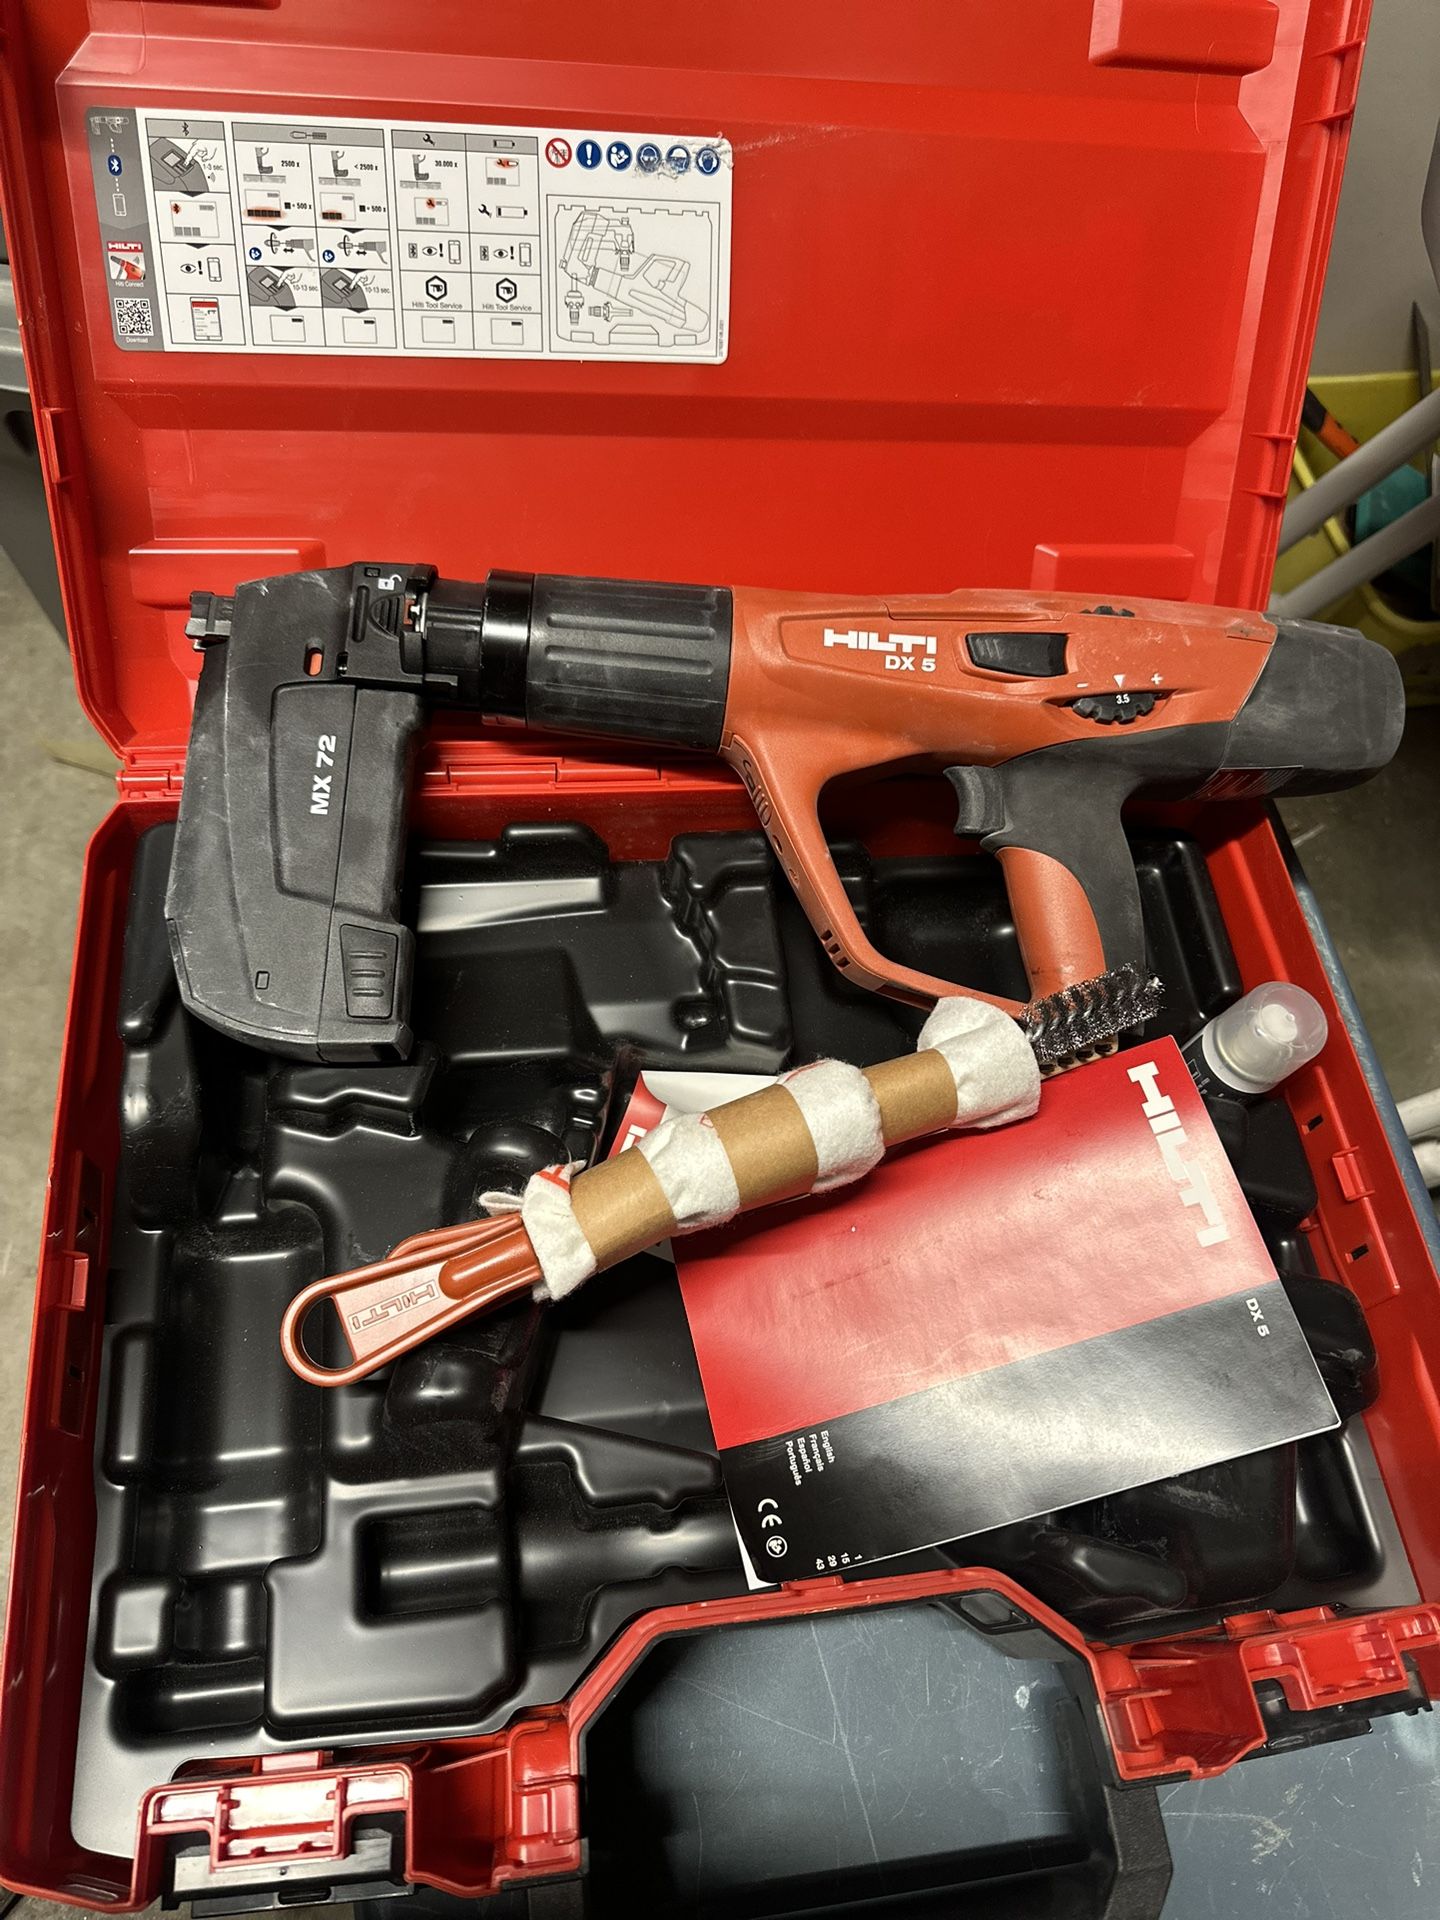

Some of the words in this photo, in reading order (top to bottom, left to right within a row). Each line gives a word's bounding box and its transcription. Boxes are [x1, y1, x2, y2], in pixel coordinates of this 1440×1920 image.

[108, 242, 142, 250] HILTI
[824, 628, 937, 653] HILTI
[885, 655, 915, 671] DX
[921, 657, 936, 672] 5
[1116, 694, 1130, 705] 3.5
[316, 734, 336, 768] 72
[310, 774, 332, 815] MX
[1127, 1061, 1231, 1248] HILTI
[352, 1284, 435, 1330] HILTI
[1246, 1298, 1264, 1322] DX
[1257, 1324, 1270, 1337] 5
[785, 1440, 802, 1486] Português
[797, 1437, 813, 1473] Español
[809, 1433, 824, 1472] Français
[821, 1430, 836, 1463] English
[815, 1558, 825, 1570] 43
[827, 1555, 837, 1567] 29
[840, 1552, 850, 1564] 15
